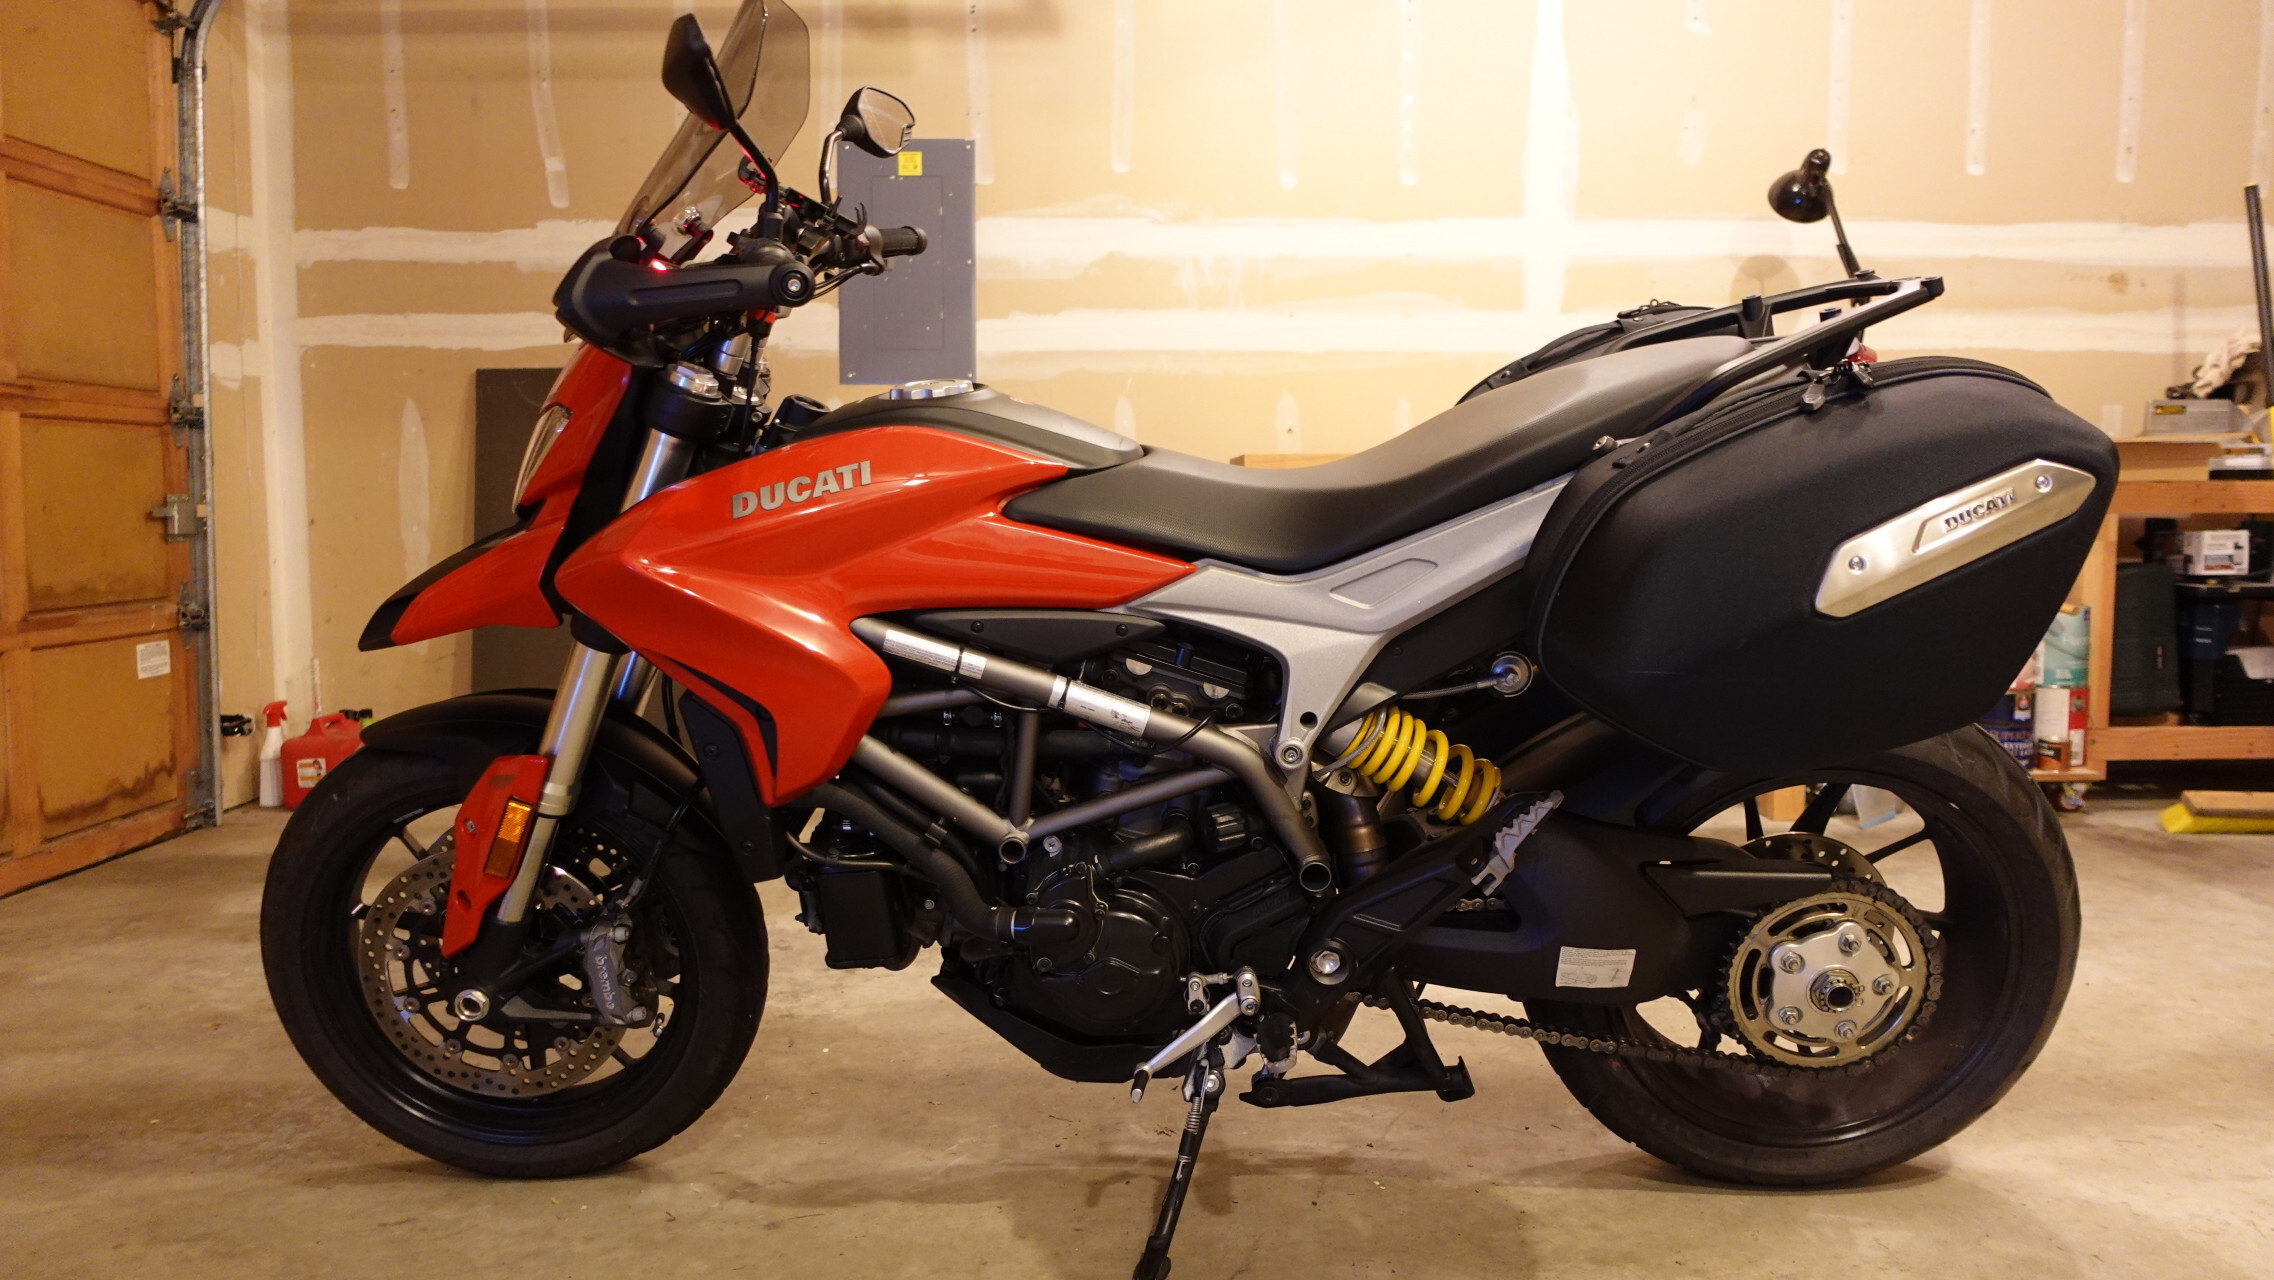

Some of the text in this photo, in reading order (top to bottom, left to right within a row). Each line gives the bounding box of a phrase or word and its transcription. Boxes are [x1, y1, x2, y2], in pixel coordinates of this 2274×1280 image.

[731, 460, 872, 520] DUCATI
[1944, 488, 2015, 533] DUCATI
[594, 955, 616, 1010] brembo
